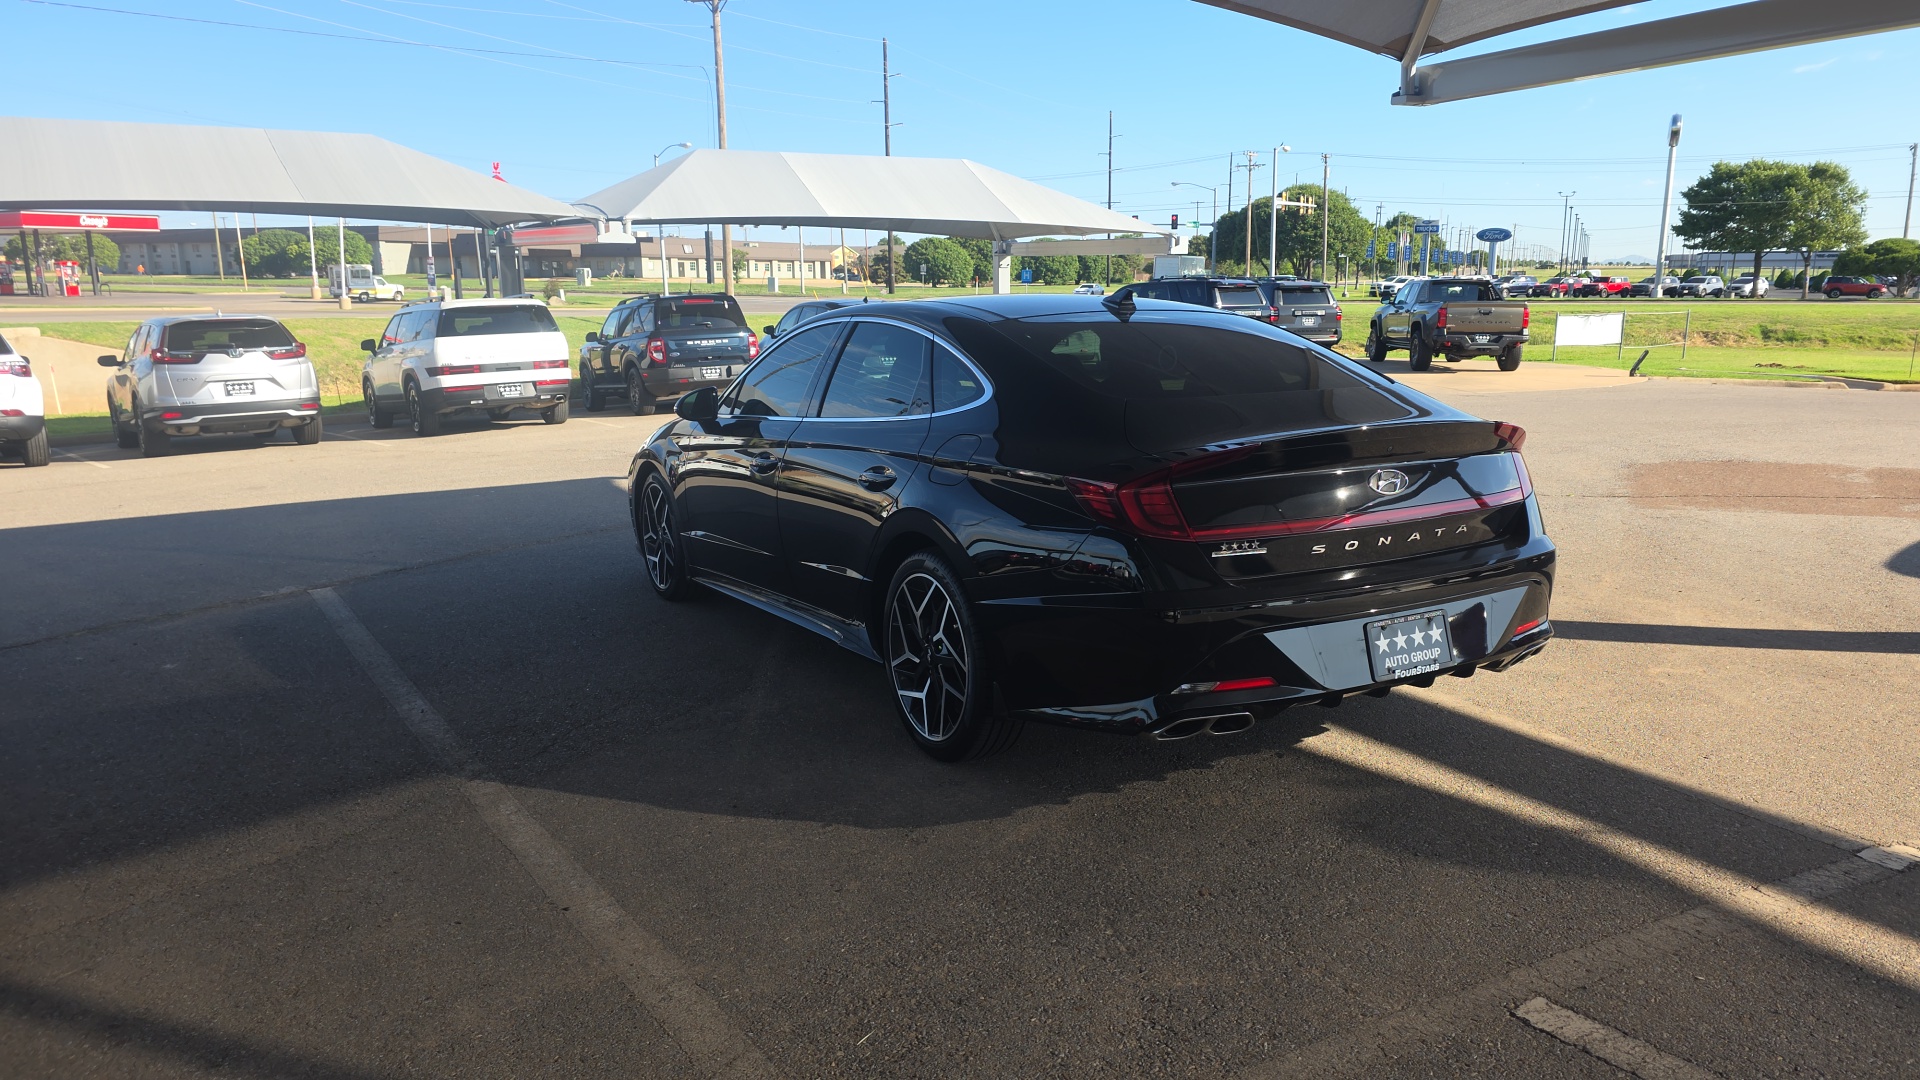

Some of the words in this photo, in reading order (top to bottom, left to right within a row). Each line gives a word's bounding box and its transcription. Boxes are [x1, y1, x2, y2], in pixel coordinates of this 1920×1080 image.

[1483, 230, 1505, 240] Ford
[1023, 271, 1030, 280] H
[1311, 524, 1468, 555] SONATA
[1385, 653, 1410, 669] AUTO
[1410, 647, 1441, 663] GROUP
